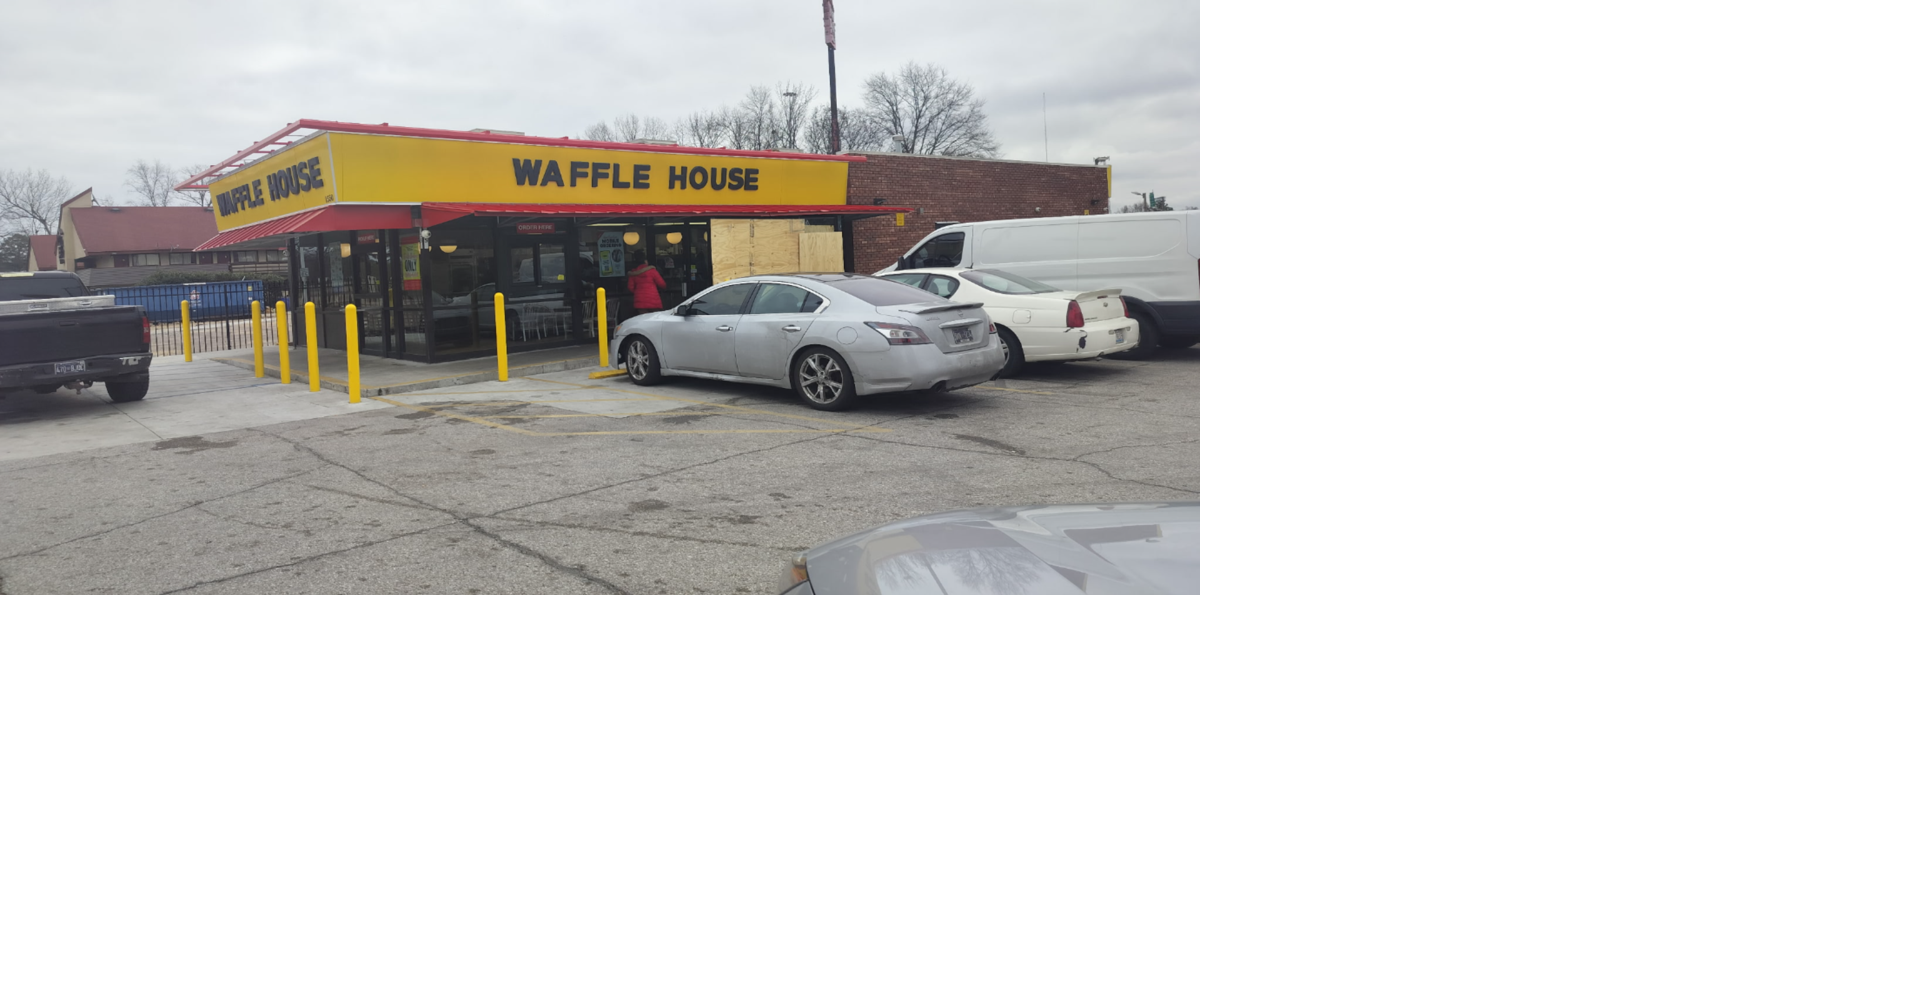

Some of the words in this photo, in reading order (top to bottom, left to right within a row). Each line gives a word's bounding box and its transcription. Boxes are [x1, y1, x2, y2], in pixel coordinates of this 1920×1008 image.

[216, 179, 264, 217] WAFFLE
[267, 157, 324, 202] HOUSE
[512, 158, 651, 189] WAFFLE
[669, 165, 759, 191] HOUSE
